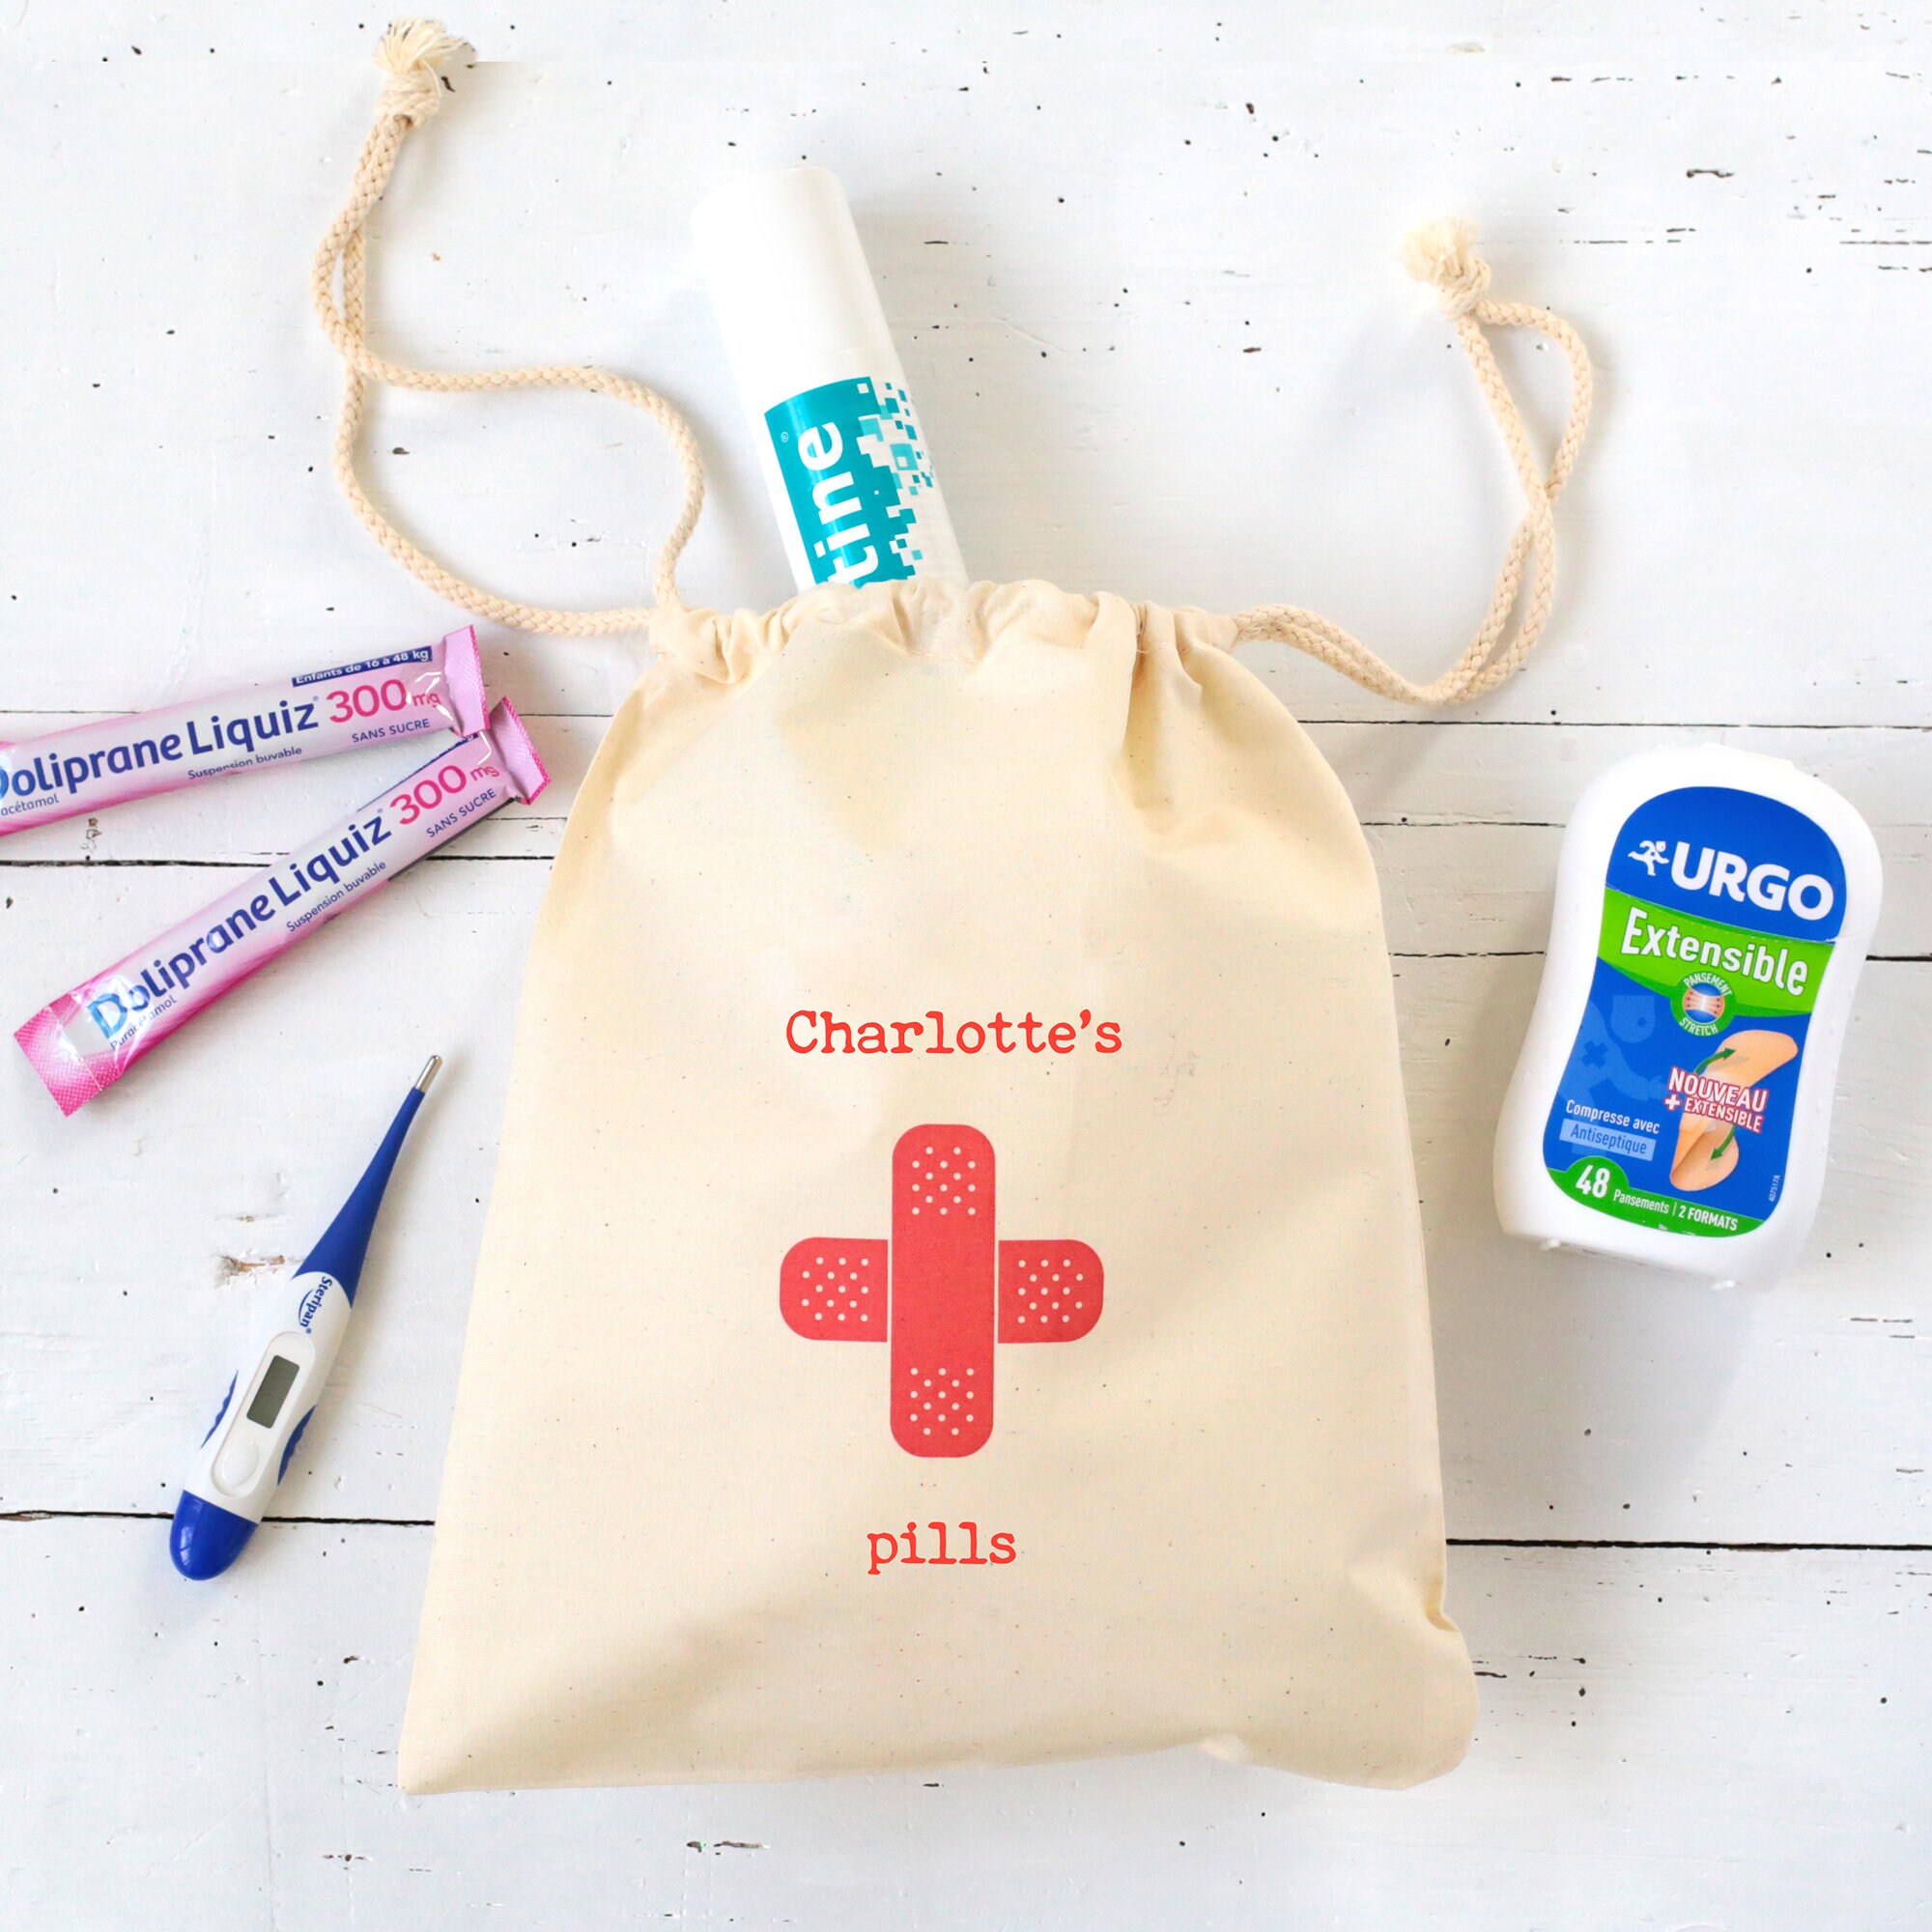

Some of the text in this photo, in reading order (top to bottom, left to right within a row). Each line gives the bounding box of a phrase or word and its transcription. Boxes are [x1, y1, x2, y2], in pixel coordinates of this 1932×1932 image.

[296, 667, 343, 685] Enfants
[345, 661, 362, 674] de
[366, 658, 381, 668] 16
[392, 651, 410, 663] 48
[412, 647, 429, 662] kg
[186, 700, 319, 755] Liquiz
[327, 679, 408, 724] 300
[412, 693, 441, 708] mg
[352, 718, 431, 743] SANS SUCRE
[187, 746, 302, 781] Suspension buvable
[426, 788, 497, 838] SANS SUCRE
[87, 765, 500, 1039] Doliprane Liquiz 300 mg
[286, 862, 386, 932] Suspension buvable
[1671, 841, 1834, 921] URGO
[1620, 906, 1808, 997] Extensible
[1683, 972, 1733, 997] PANSEMENT
[786, 1009, 1122, 1054] Charlotte’s
[1678, 1016, 1719, 1037] STRETCH
[1668, 1067, 1768, 1112] NOUVEAU
[1566, 1099, 1660, 1134] Compresse avec
[1685, 1097, 1763, 1133] EXTENSIBLE
[1570, 1123, 1647, 1154] Antiseptique
[1576, 1164, 1739, 1231] 48 Pansements 2 FORMATS
[299, 1276, 333, 1327] Steripan
[867, 1521, 1016, 1575] pills
